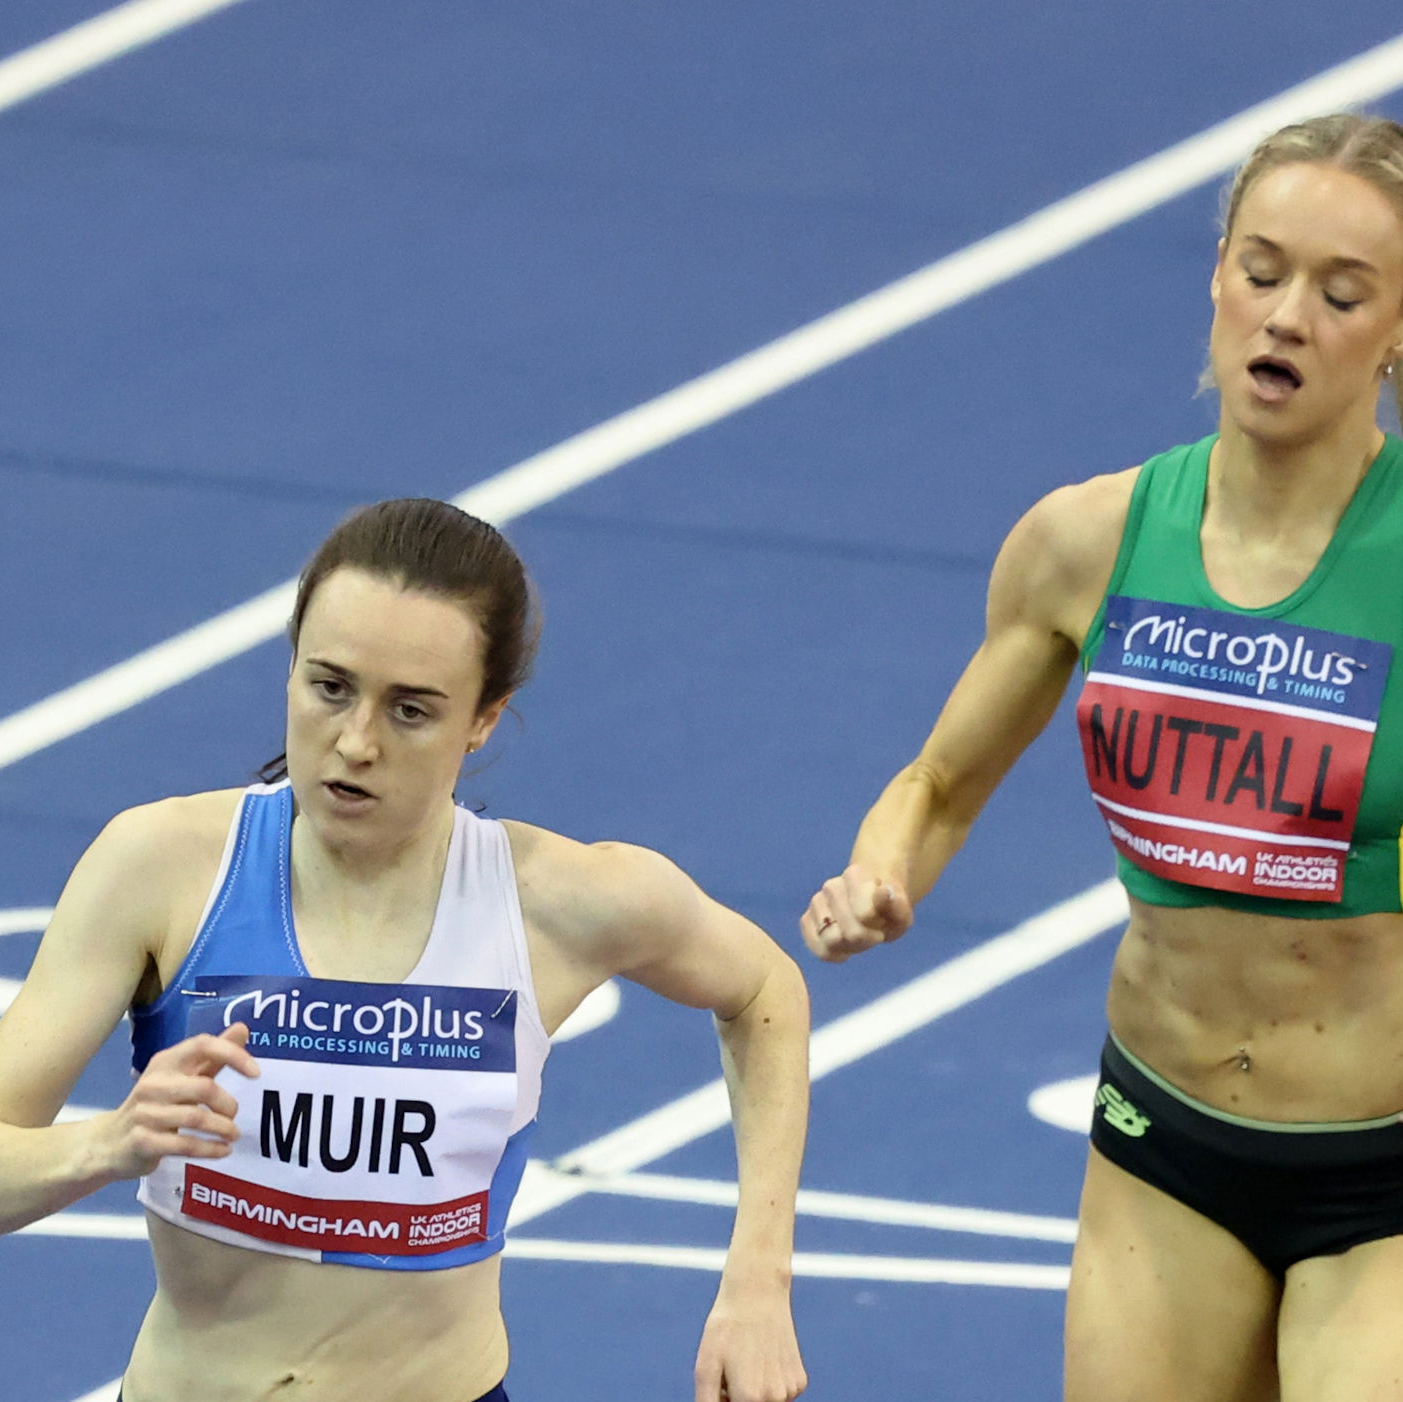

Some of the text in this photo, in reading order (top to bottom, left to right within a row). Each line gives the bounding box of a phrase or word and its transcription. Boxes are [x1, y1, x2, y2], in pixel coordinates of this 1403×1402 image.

[1121, 652, 1346, 704] DATA PROCESSING & TIMING
[1090, 703, 1343, 822] NUTTALL
[1254, 862, 1338, 882] INDOOR
[246, 1031, 481, 1060] TA PROCESSING & TIMING
[259, 1089, 437, 1177] MUIR
[190, 1182, 400, 1240] BIRMINGHAM
[408, 1212, 481, 1239] INDOOR
[410, 1202, 482, 1225] UK ATHLETICS
